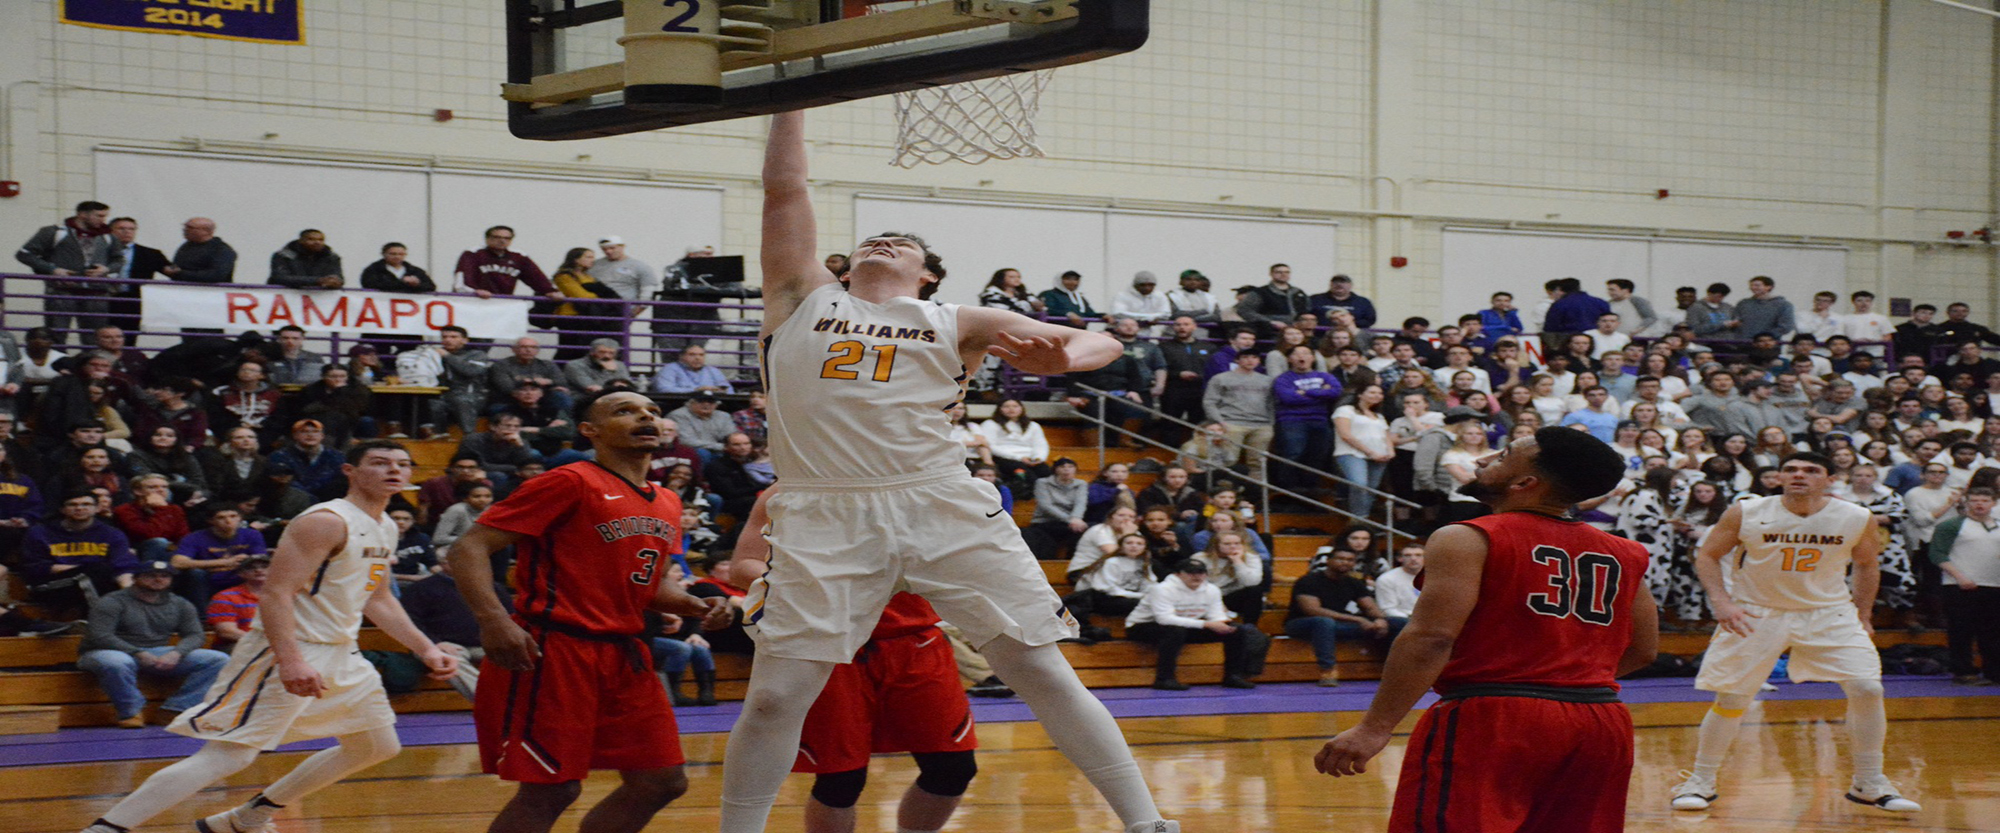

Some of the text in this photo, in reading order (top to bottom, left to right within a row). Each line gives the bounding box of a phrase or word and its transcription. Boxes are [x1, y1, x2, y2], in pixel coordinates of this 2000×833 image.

[144, 7, 225, 28] 2014
[662, 0, 699, 33] 2
[226, 292, 455, 330] RAMAPO
[813, 318, 936, 343] WILLIAMS
[820, 340, 897, 382] 21
[1762, 533, 1844, 545] WILLIAMS
[630, 548, 660, 585] 3
[1780, 547, 1823, 572] 12
[364, 563, 387, 592] 5
[1526, 544, 1622, 626] 30
